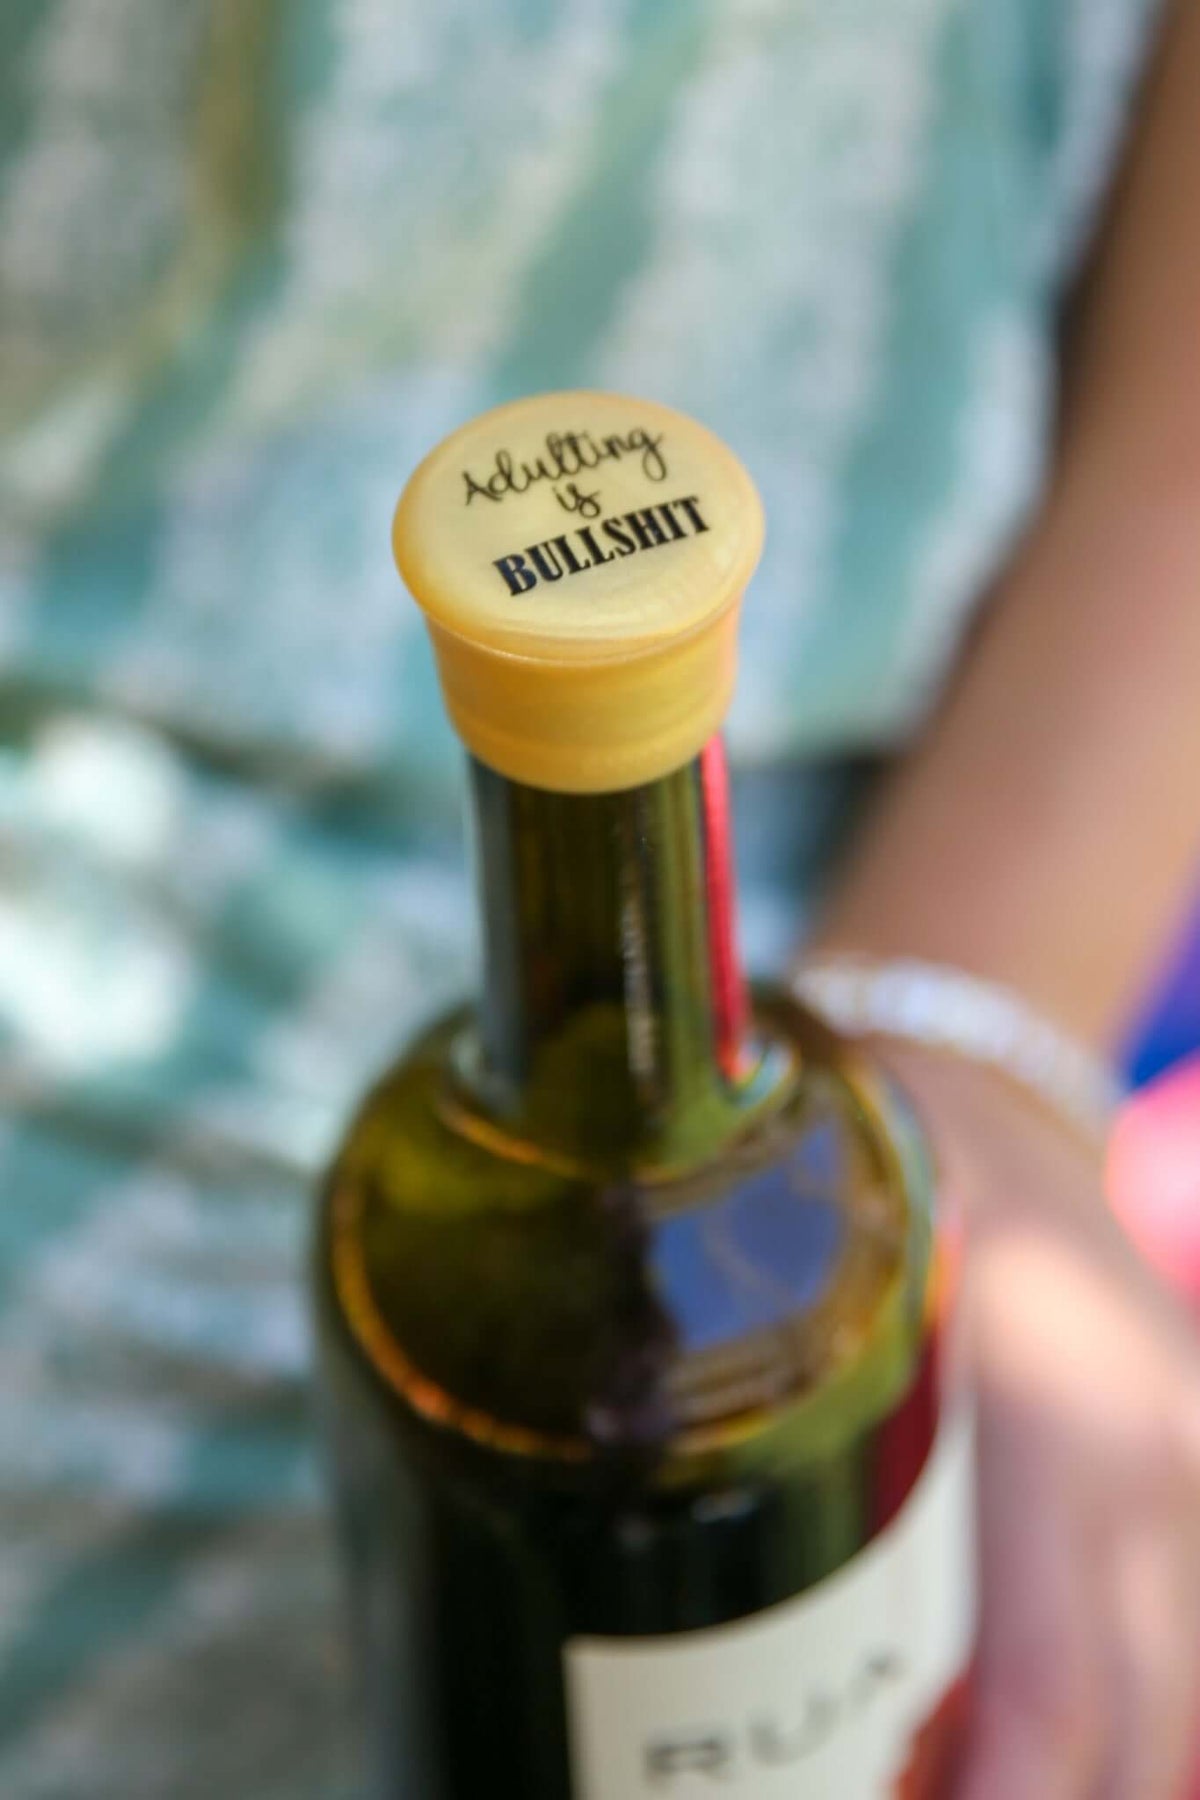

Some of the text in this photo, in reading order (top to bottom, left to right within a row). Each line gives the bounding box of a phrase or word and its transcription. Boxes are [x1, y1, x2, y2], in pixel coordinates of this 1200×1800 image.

[462, 427, 668, 505] Adulting
[552, 483, 602, 518] is
[492, 496, 710, 596] BULLSHIT
